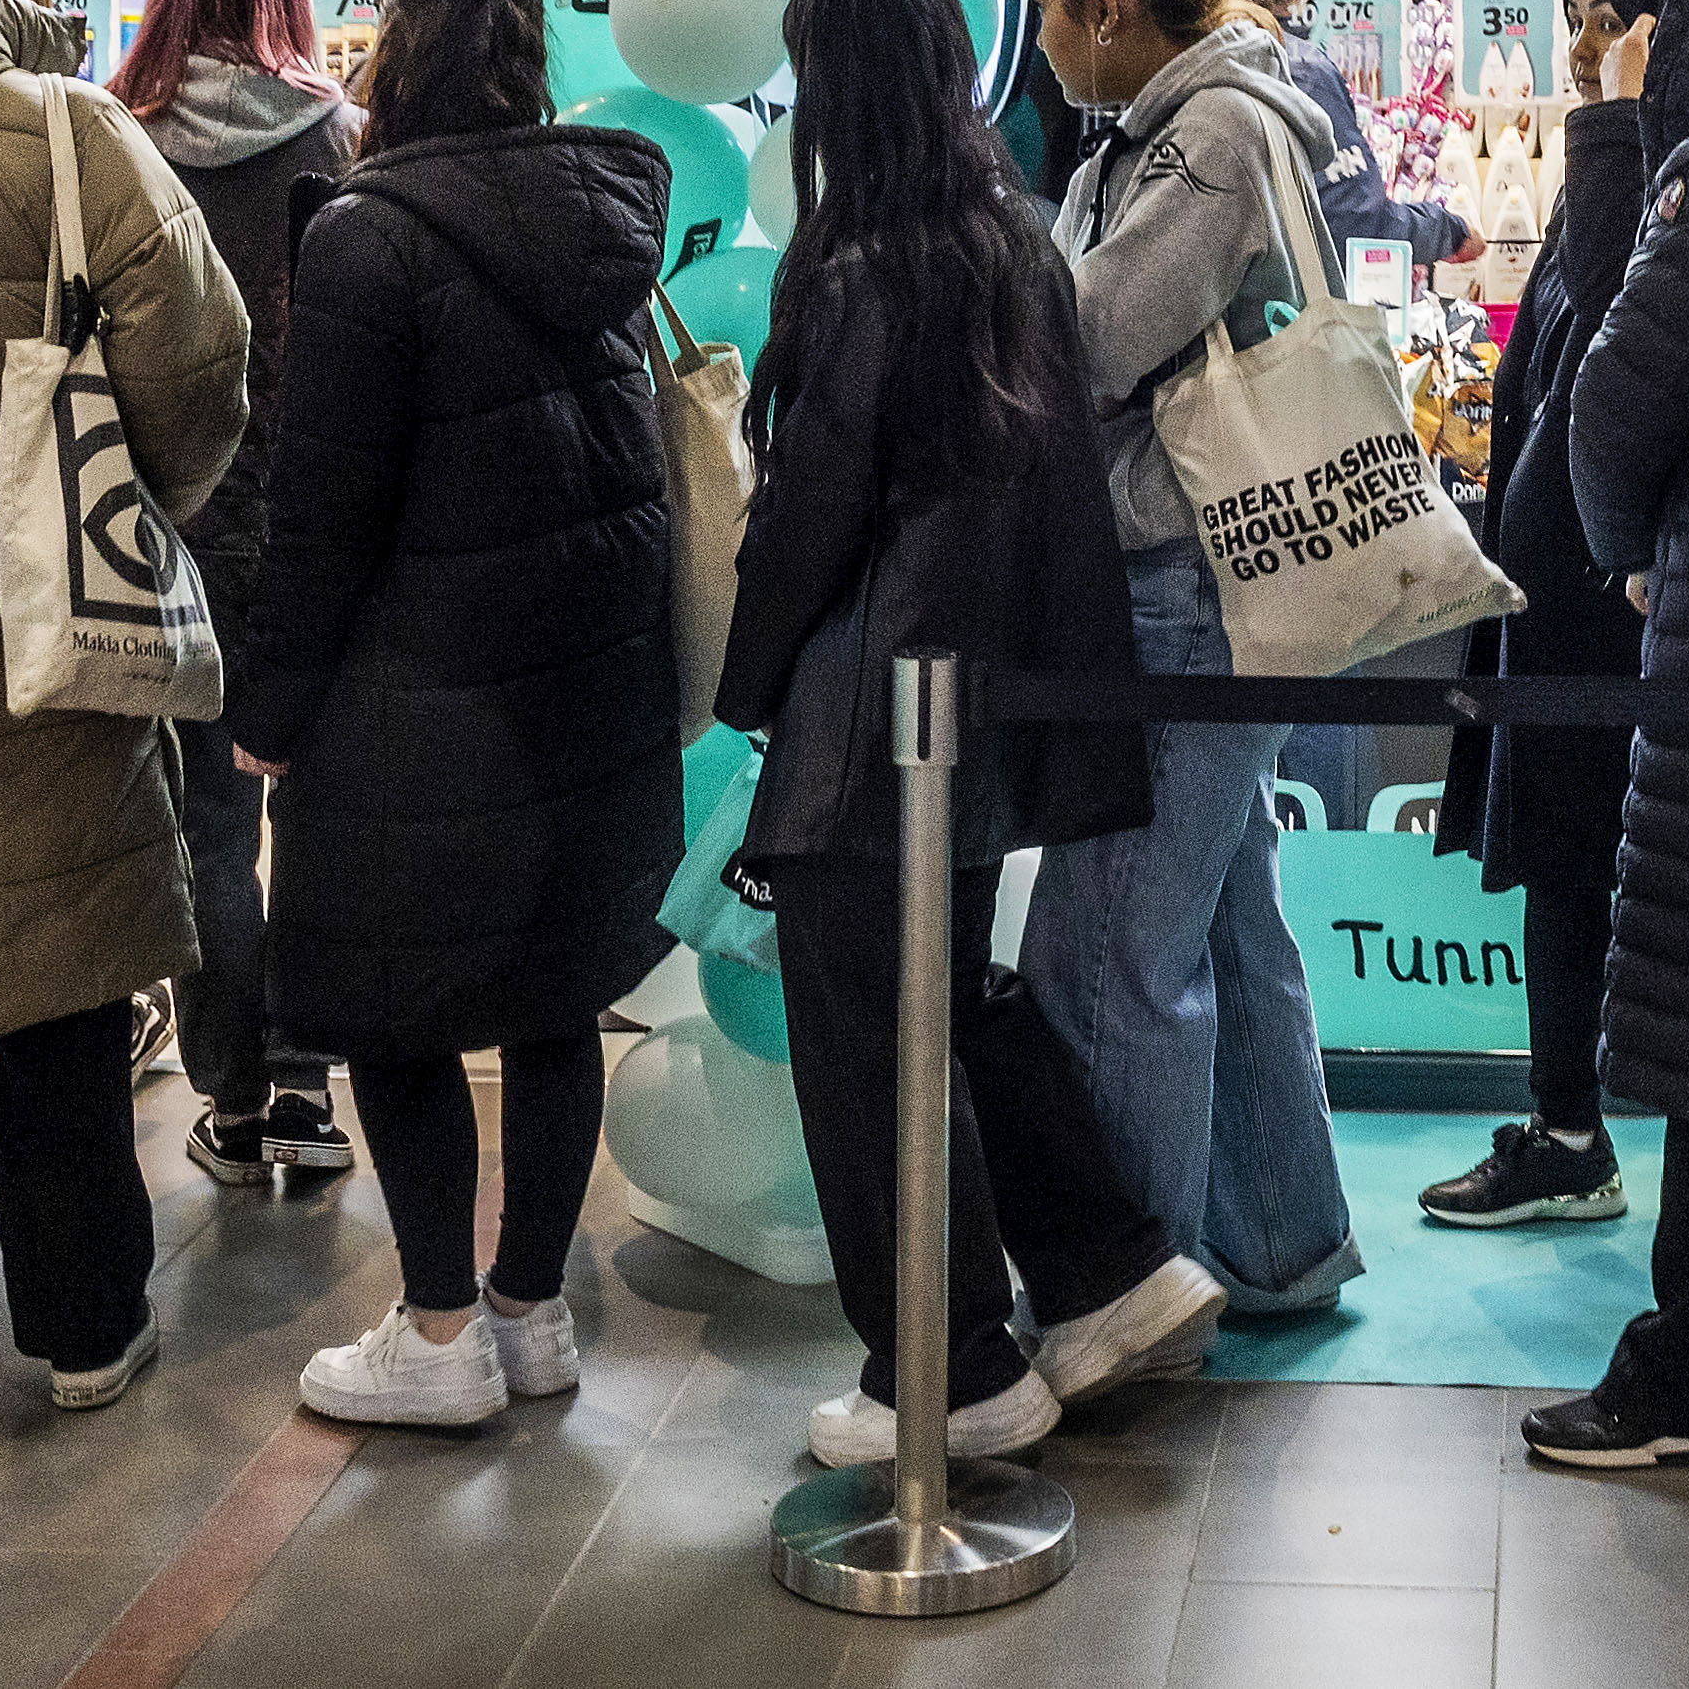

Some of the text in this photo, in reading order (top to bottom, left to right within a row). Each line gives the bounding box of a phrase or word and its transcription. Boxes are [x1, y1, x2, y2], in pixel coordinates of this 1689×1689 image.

[1202, 431, 1420, 532] GREAT FASHION
[1210, 460, 1425, 560] SHOULD NEVER
[1230, 489, 1435, 582] GO TO WASTE
